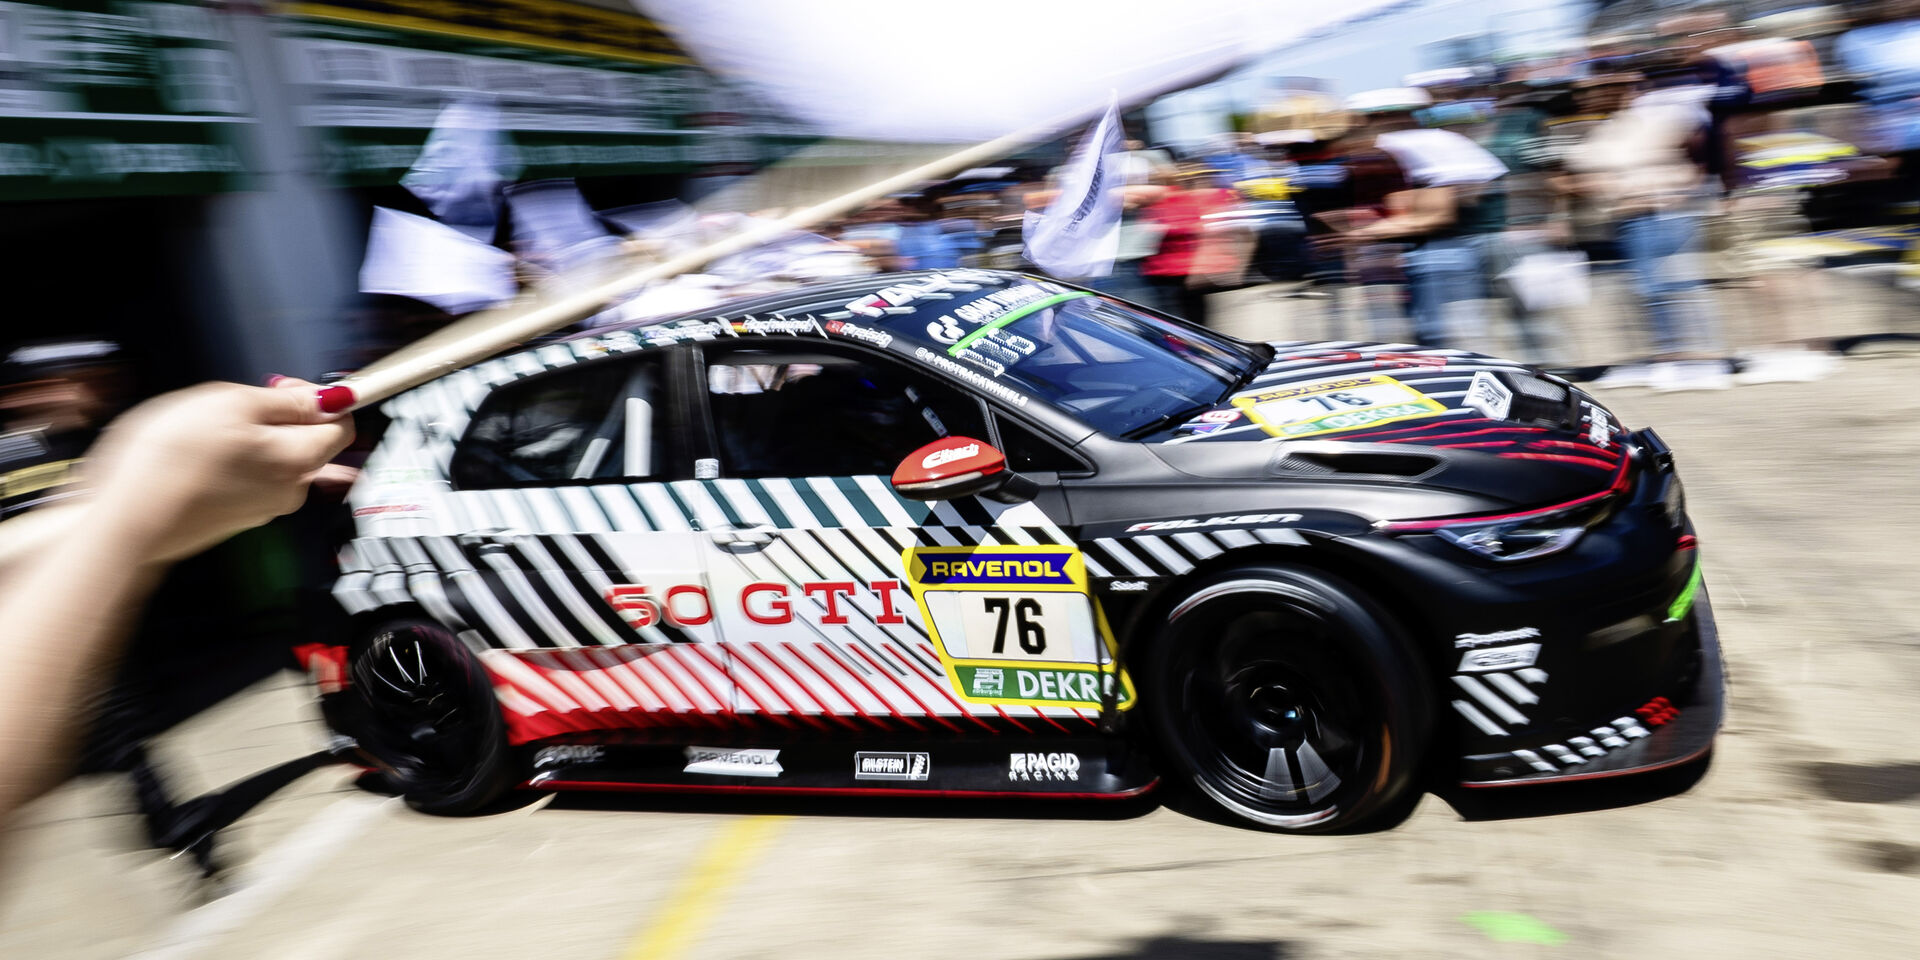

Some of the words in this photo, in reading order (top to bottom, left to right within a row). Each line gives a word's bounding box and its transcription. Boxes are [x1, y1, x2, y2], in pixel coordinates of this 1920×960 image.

[1297, 392, 1373, 412] 76
[1321, 404, 1431, 429] DEKRA
[1124, 513, 1304, 533] FALKEN
[931, 560, 1062, 578] RAVENOL
[604, 584, 714, 627] 50
[739, 579, 906, 626] GTI
[983, 597, 1047, 656] 76
[697, 751, 775, 766] RAVENOL
[862, 757, 904, 773] BILSTEIN
[1027, 753, 1080, 773] PAGID
[1009, 771, 1080, 782] RACING
